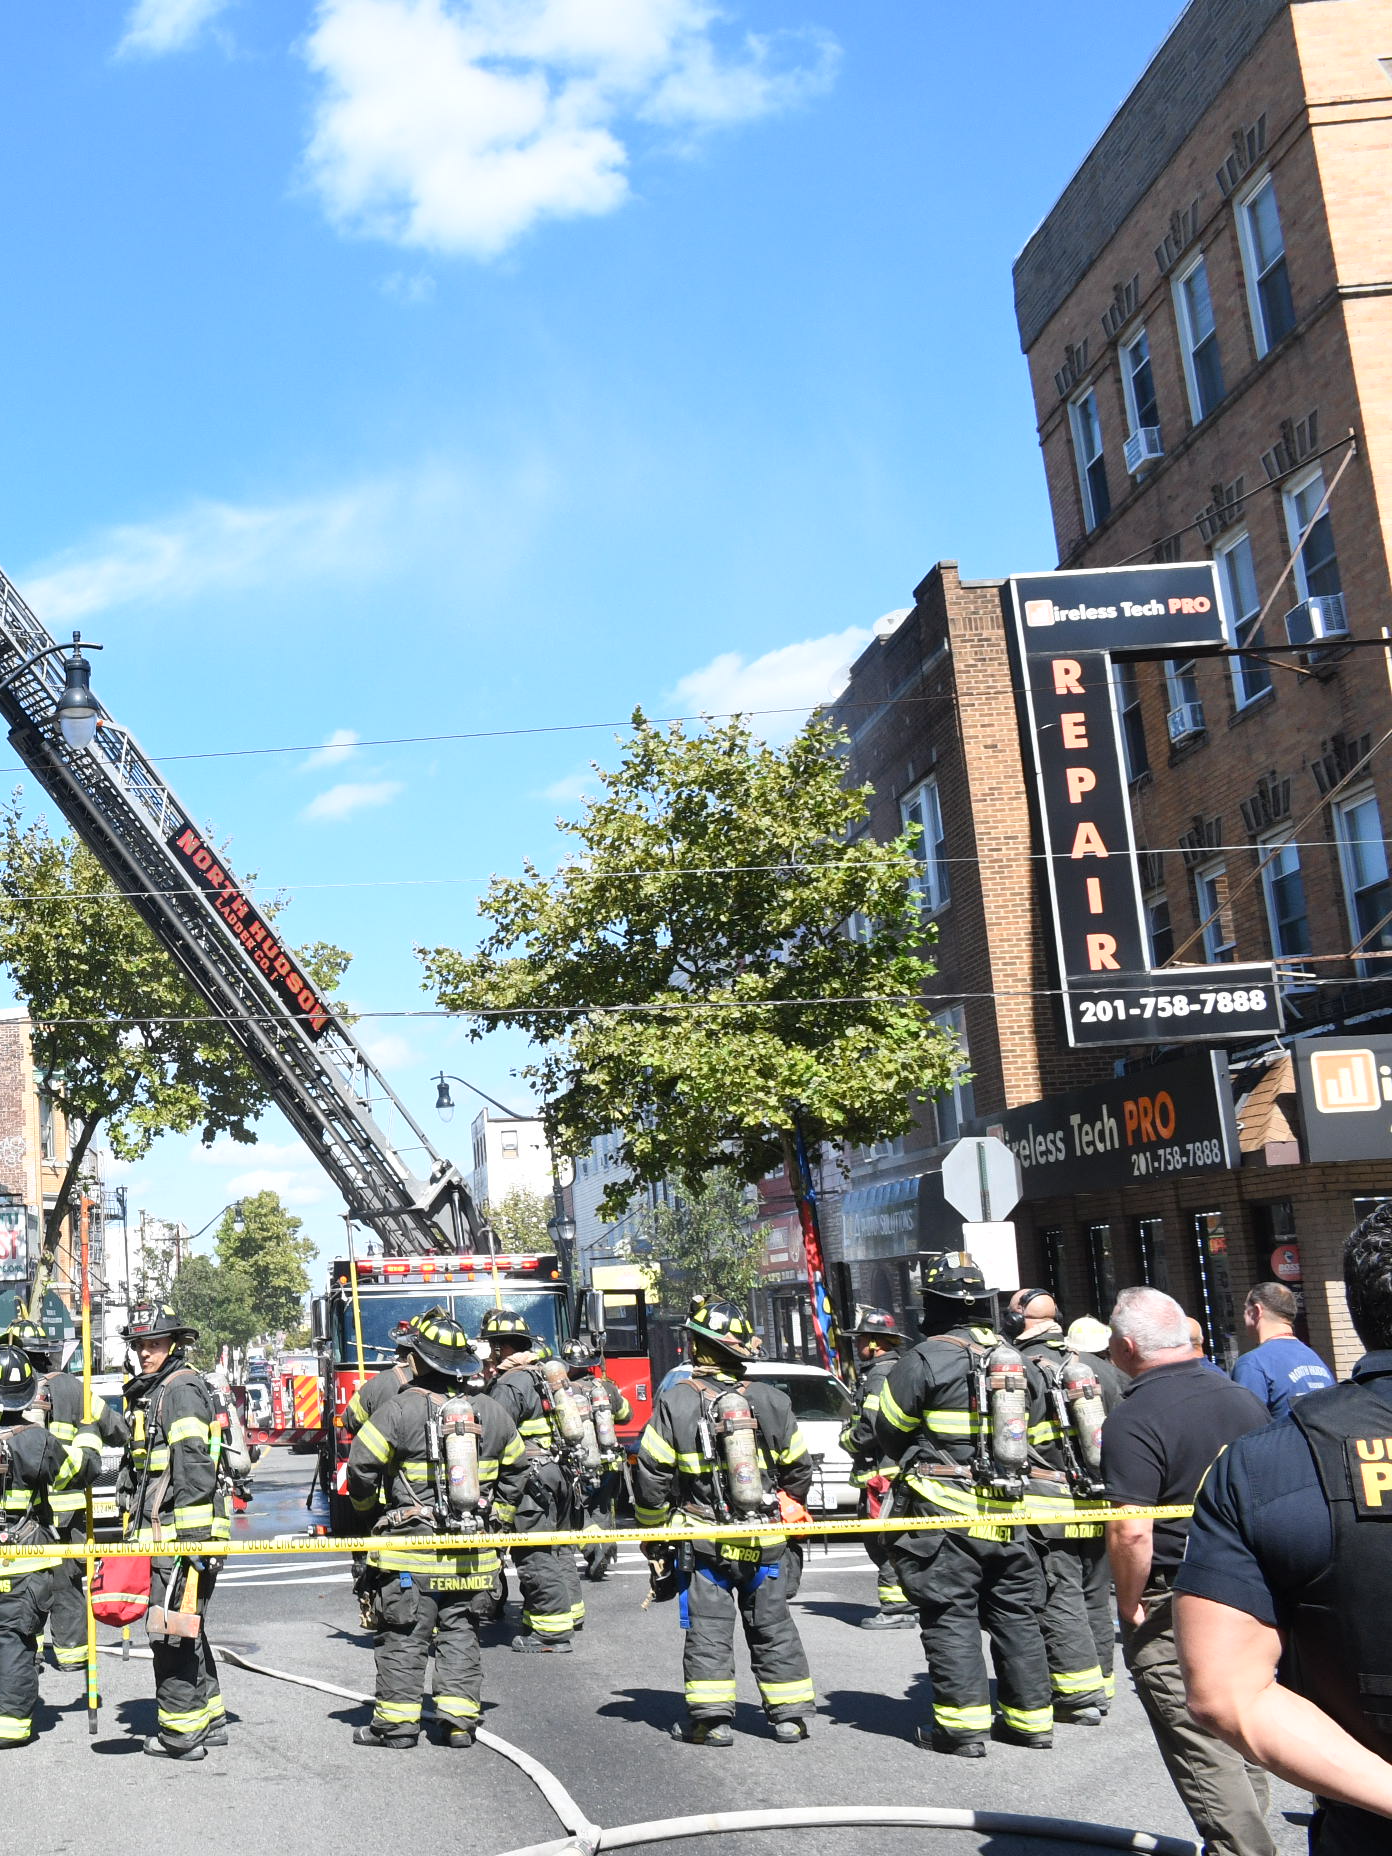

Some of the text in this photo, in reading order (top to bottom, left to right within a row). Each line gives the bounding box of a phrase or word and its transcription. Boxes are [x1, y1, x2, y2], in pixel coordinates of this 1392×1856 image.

[1120, 600, 1165, 617] Tech
[1168, 597, 1211, 614] PRO
[1051, 659, 1120, 970] REPAIR
[176, 828, 330, 1033] NORTH HUDSON
[214, 897, 254, 950] LADDER
[1079, 989, 1267, 1023] 201-758-7888
[1070, 1104, 1119, 1157] Tech
[1123, 1090, 1176, 1146] PRO
[1131, 1139, 1221, 1176] 201-758-7888
[133, 1310, 150, 1324] 13
[1064, 1524, 1104, 1538] NOTARO
[720, 1544, 760, 1562] CORBO
[429, 1575, 494, 1591] FERNANDEZ
